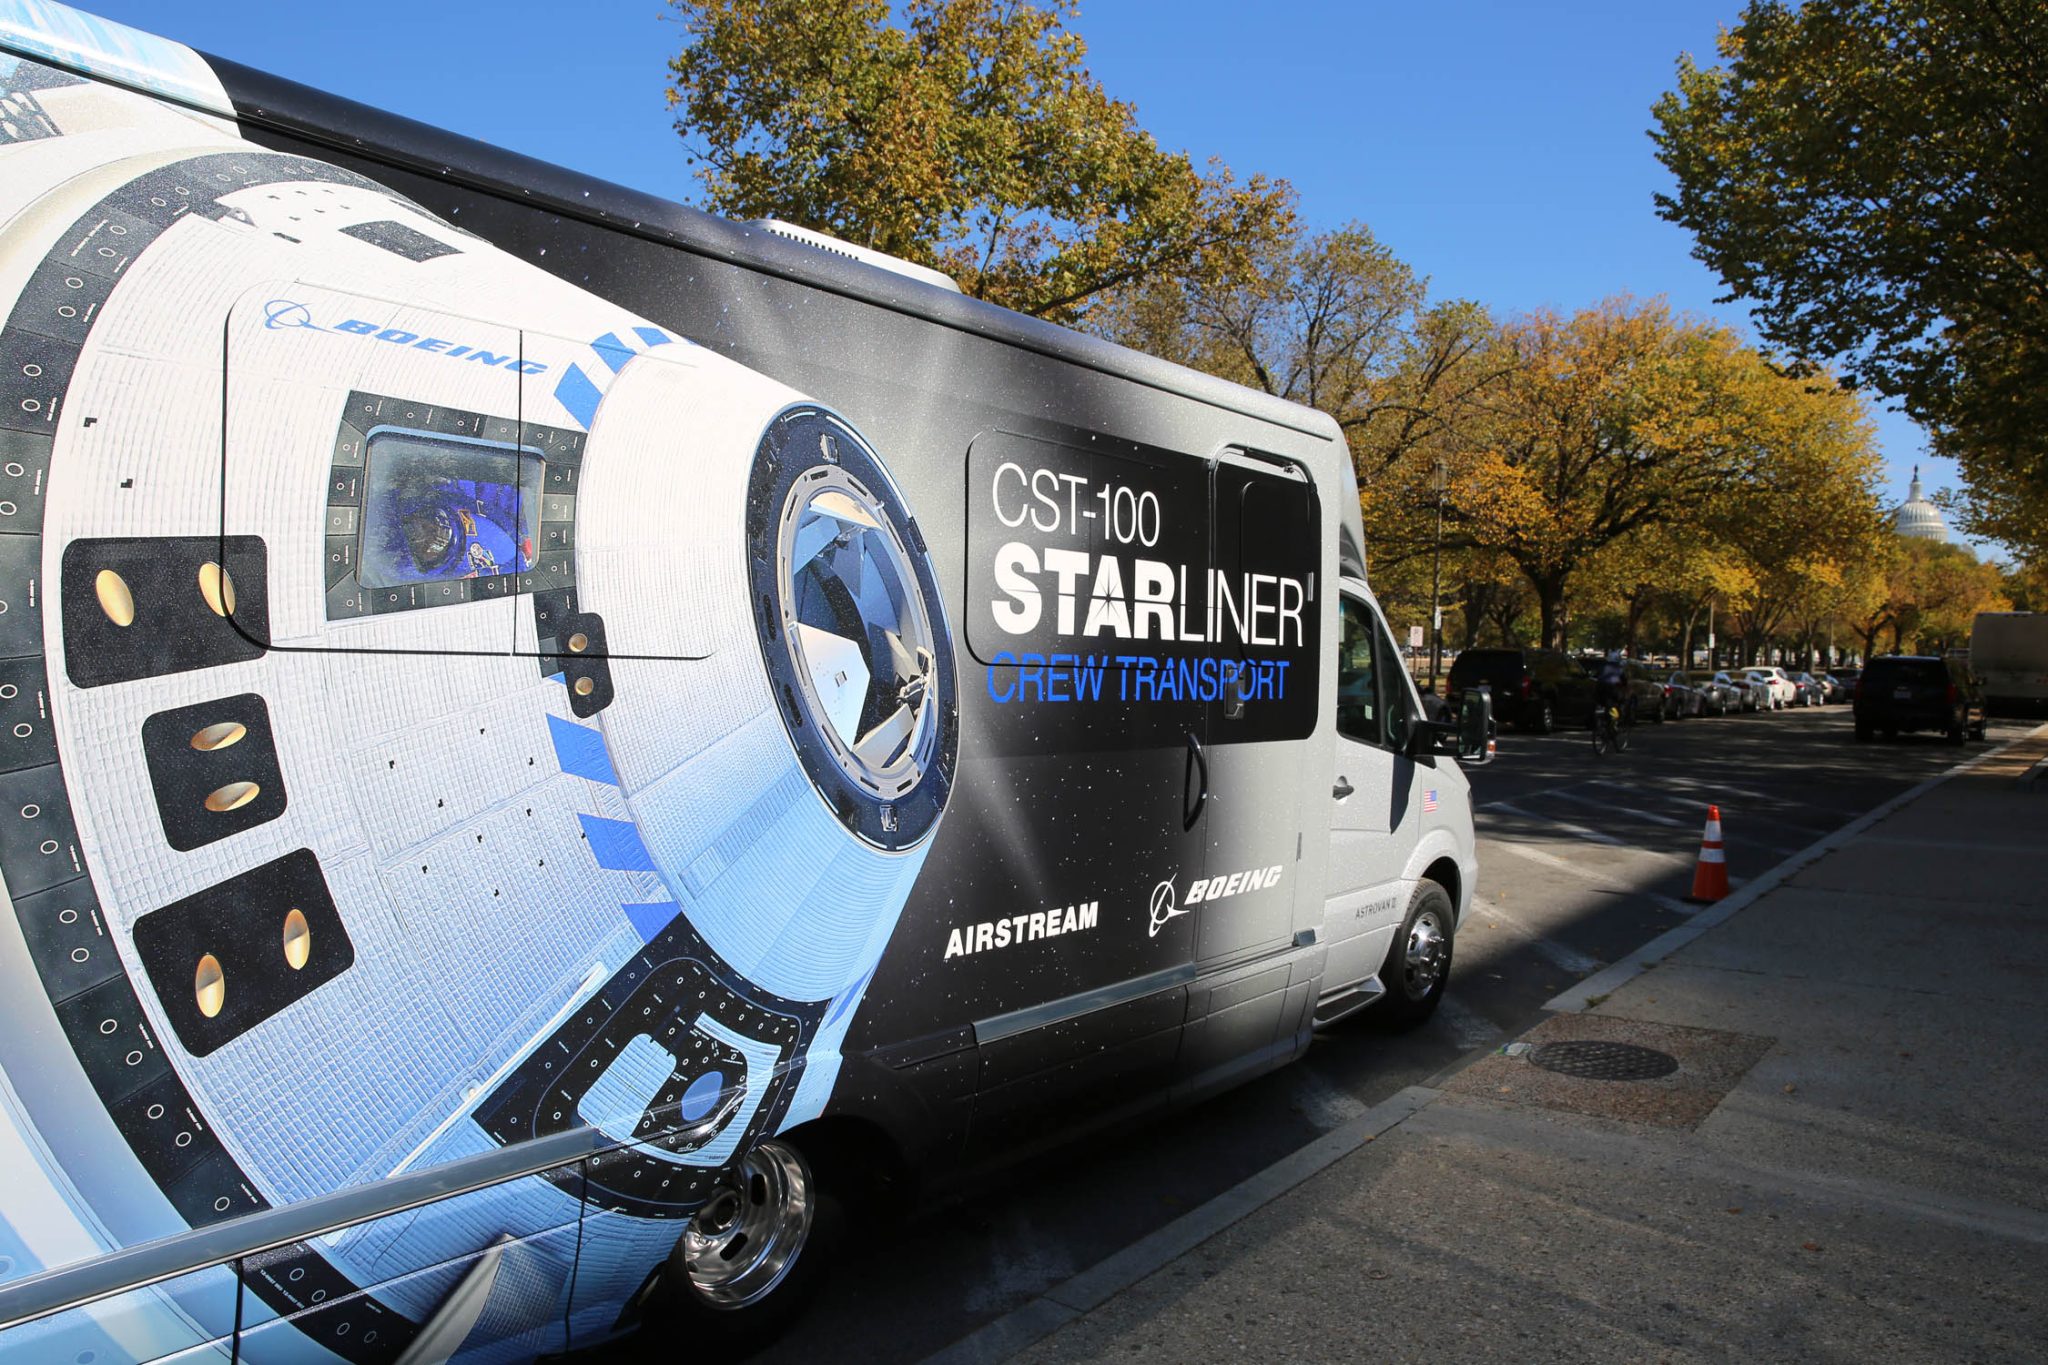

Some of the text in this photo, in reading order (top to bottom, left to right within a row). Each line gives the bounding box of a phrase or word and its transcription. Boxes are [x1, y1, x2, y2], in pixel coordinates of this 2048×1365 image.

[333, 319, 549, 375] BOEING
[992, 462, 1161, 547] CST-100
[991, 541, 1304, 647] STARLINER
[987, 651, 1290, 704] CREW TRANSPORT
[1184, 865, 1283, 905] BOEING
[1355, 898, 1391, 919] ASTROVAN
[943, 901, 1099, 959] AIRSTREAM
